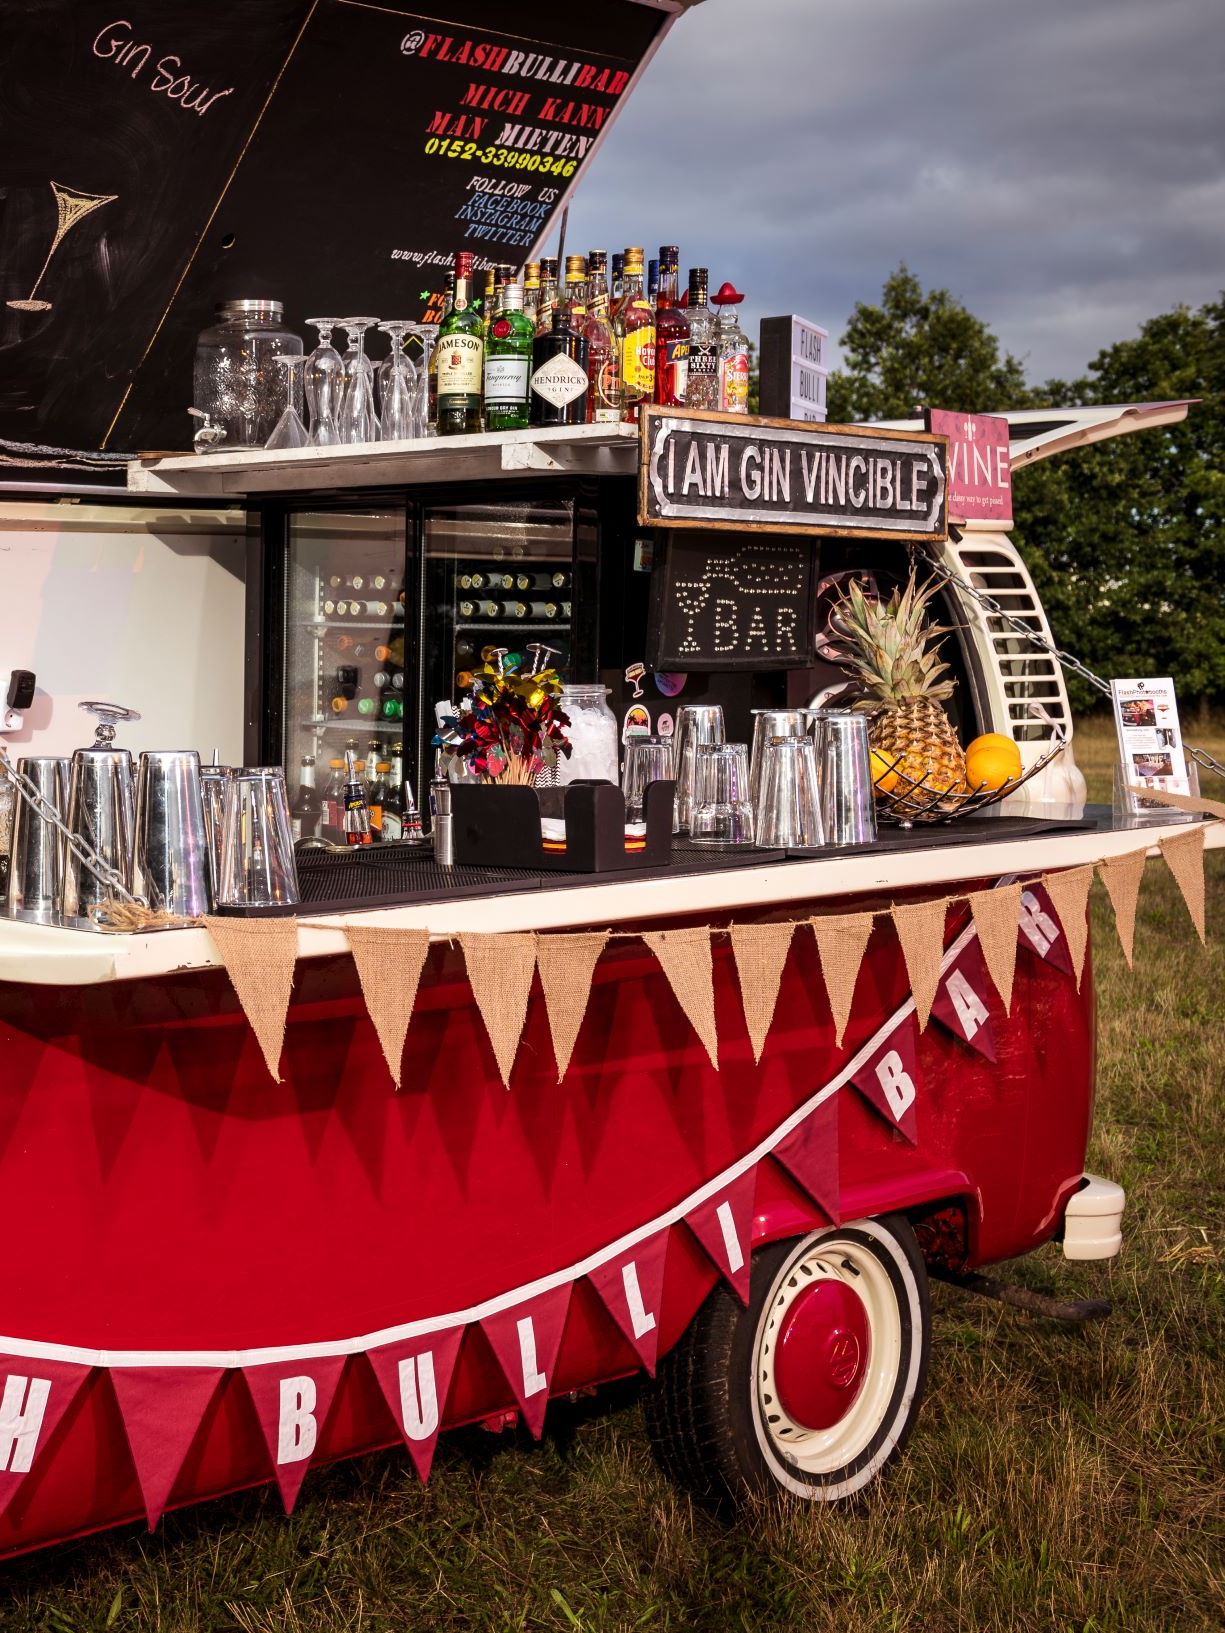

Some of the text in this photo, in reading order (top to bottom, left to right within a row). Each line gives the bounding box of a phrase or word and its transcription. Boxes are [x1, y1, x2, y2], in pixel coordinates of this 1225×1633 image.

[93, 20, 235, 116] Gin Sour
[459, 83, 611, 130] MICH KANN
[425, 111, 595, 160] MAN MIETEN
[424, 138, 578, 177] 0152-33990346
[465, 176, 559, 203] FOLLOW US
[467, 192, 553, 218] FACEBOOK
[454, 205, 543, 232] INSTAGRAM
[464, 223, 535, 247] TWITTER
[438, 338, 480, 353] JAMESON
[800, 328, 822, 363] FLASH
[533, 375, 586, 385] HENDRICK'S
[799, 370, 820, 403] BULLI
[668, 438, 929, 512] I AM GIN VINCIBLE
[714, 598, 798, 653] BAR
